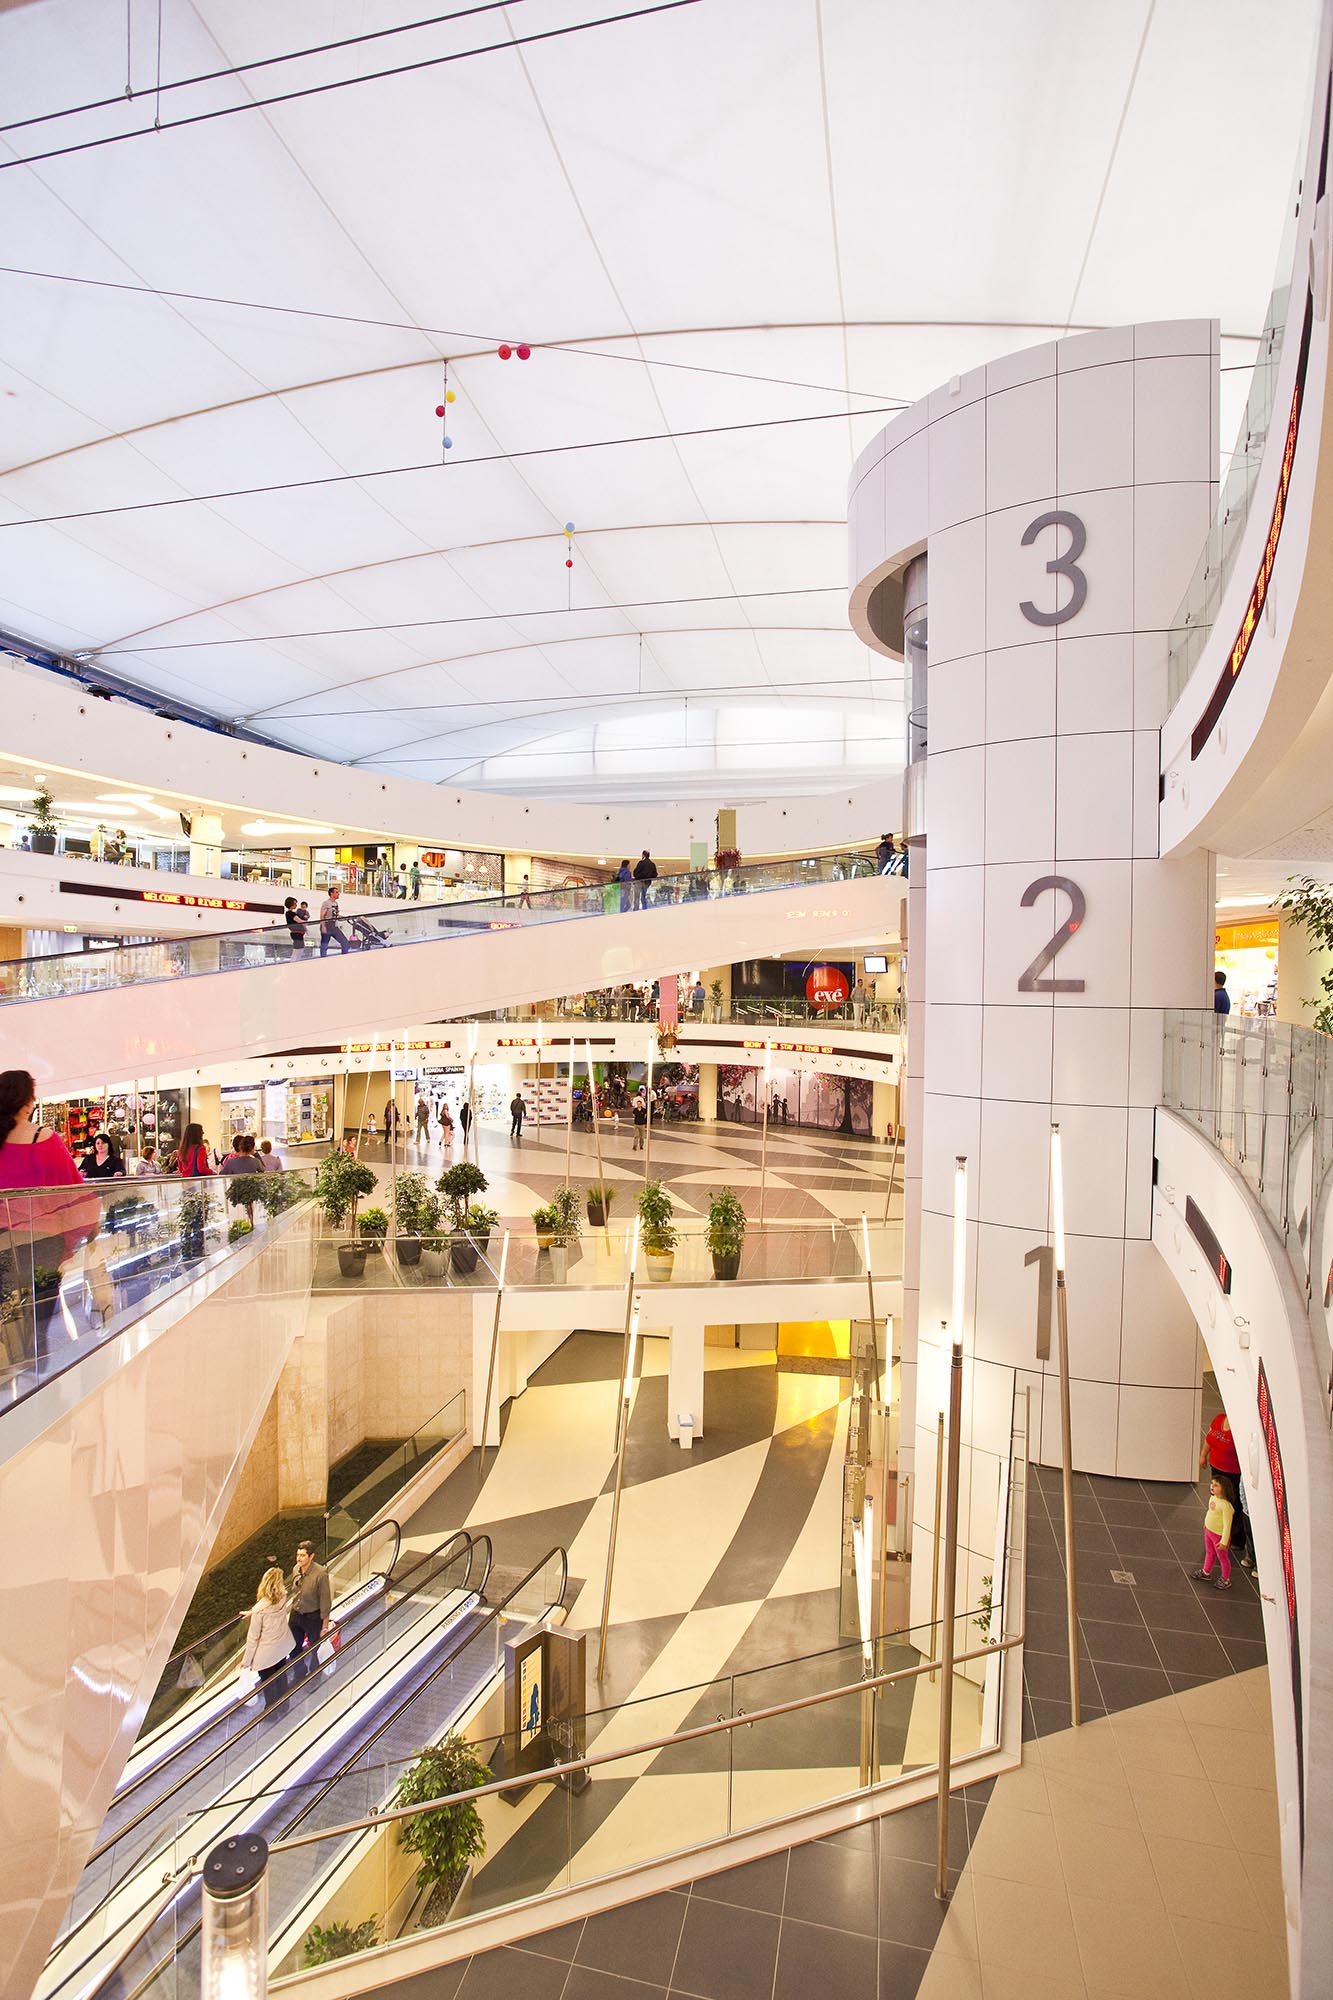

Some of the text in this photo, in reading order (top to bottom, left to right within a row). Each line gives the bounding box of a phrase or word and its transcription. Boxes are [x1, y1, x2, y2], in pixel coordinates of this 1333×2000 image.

[1019, 510, 1088, 627] 3
[143, 892, 246, 910] WELCOME TO RIVER WEST
[1018, 875, 1086, 993] 2
[814, 988, 843, 1002] exé
[429, 1041, 446, 1049] WEST
[1024, 1245, 1053, 1361] 1
[441, 1611, 461, 1629] PARKING
